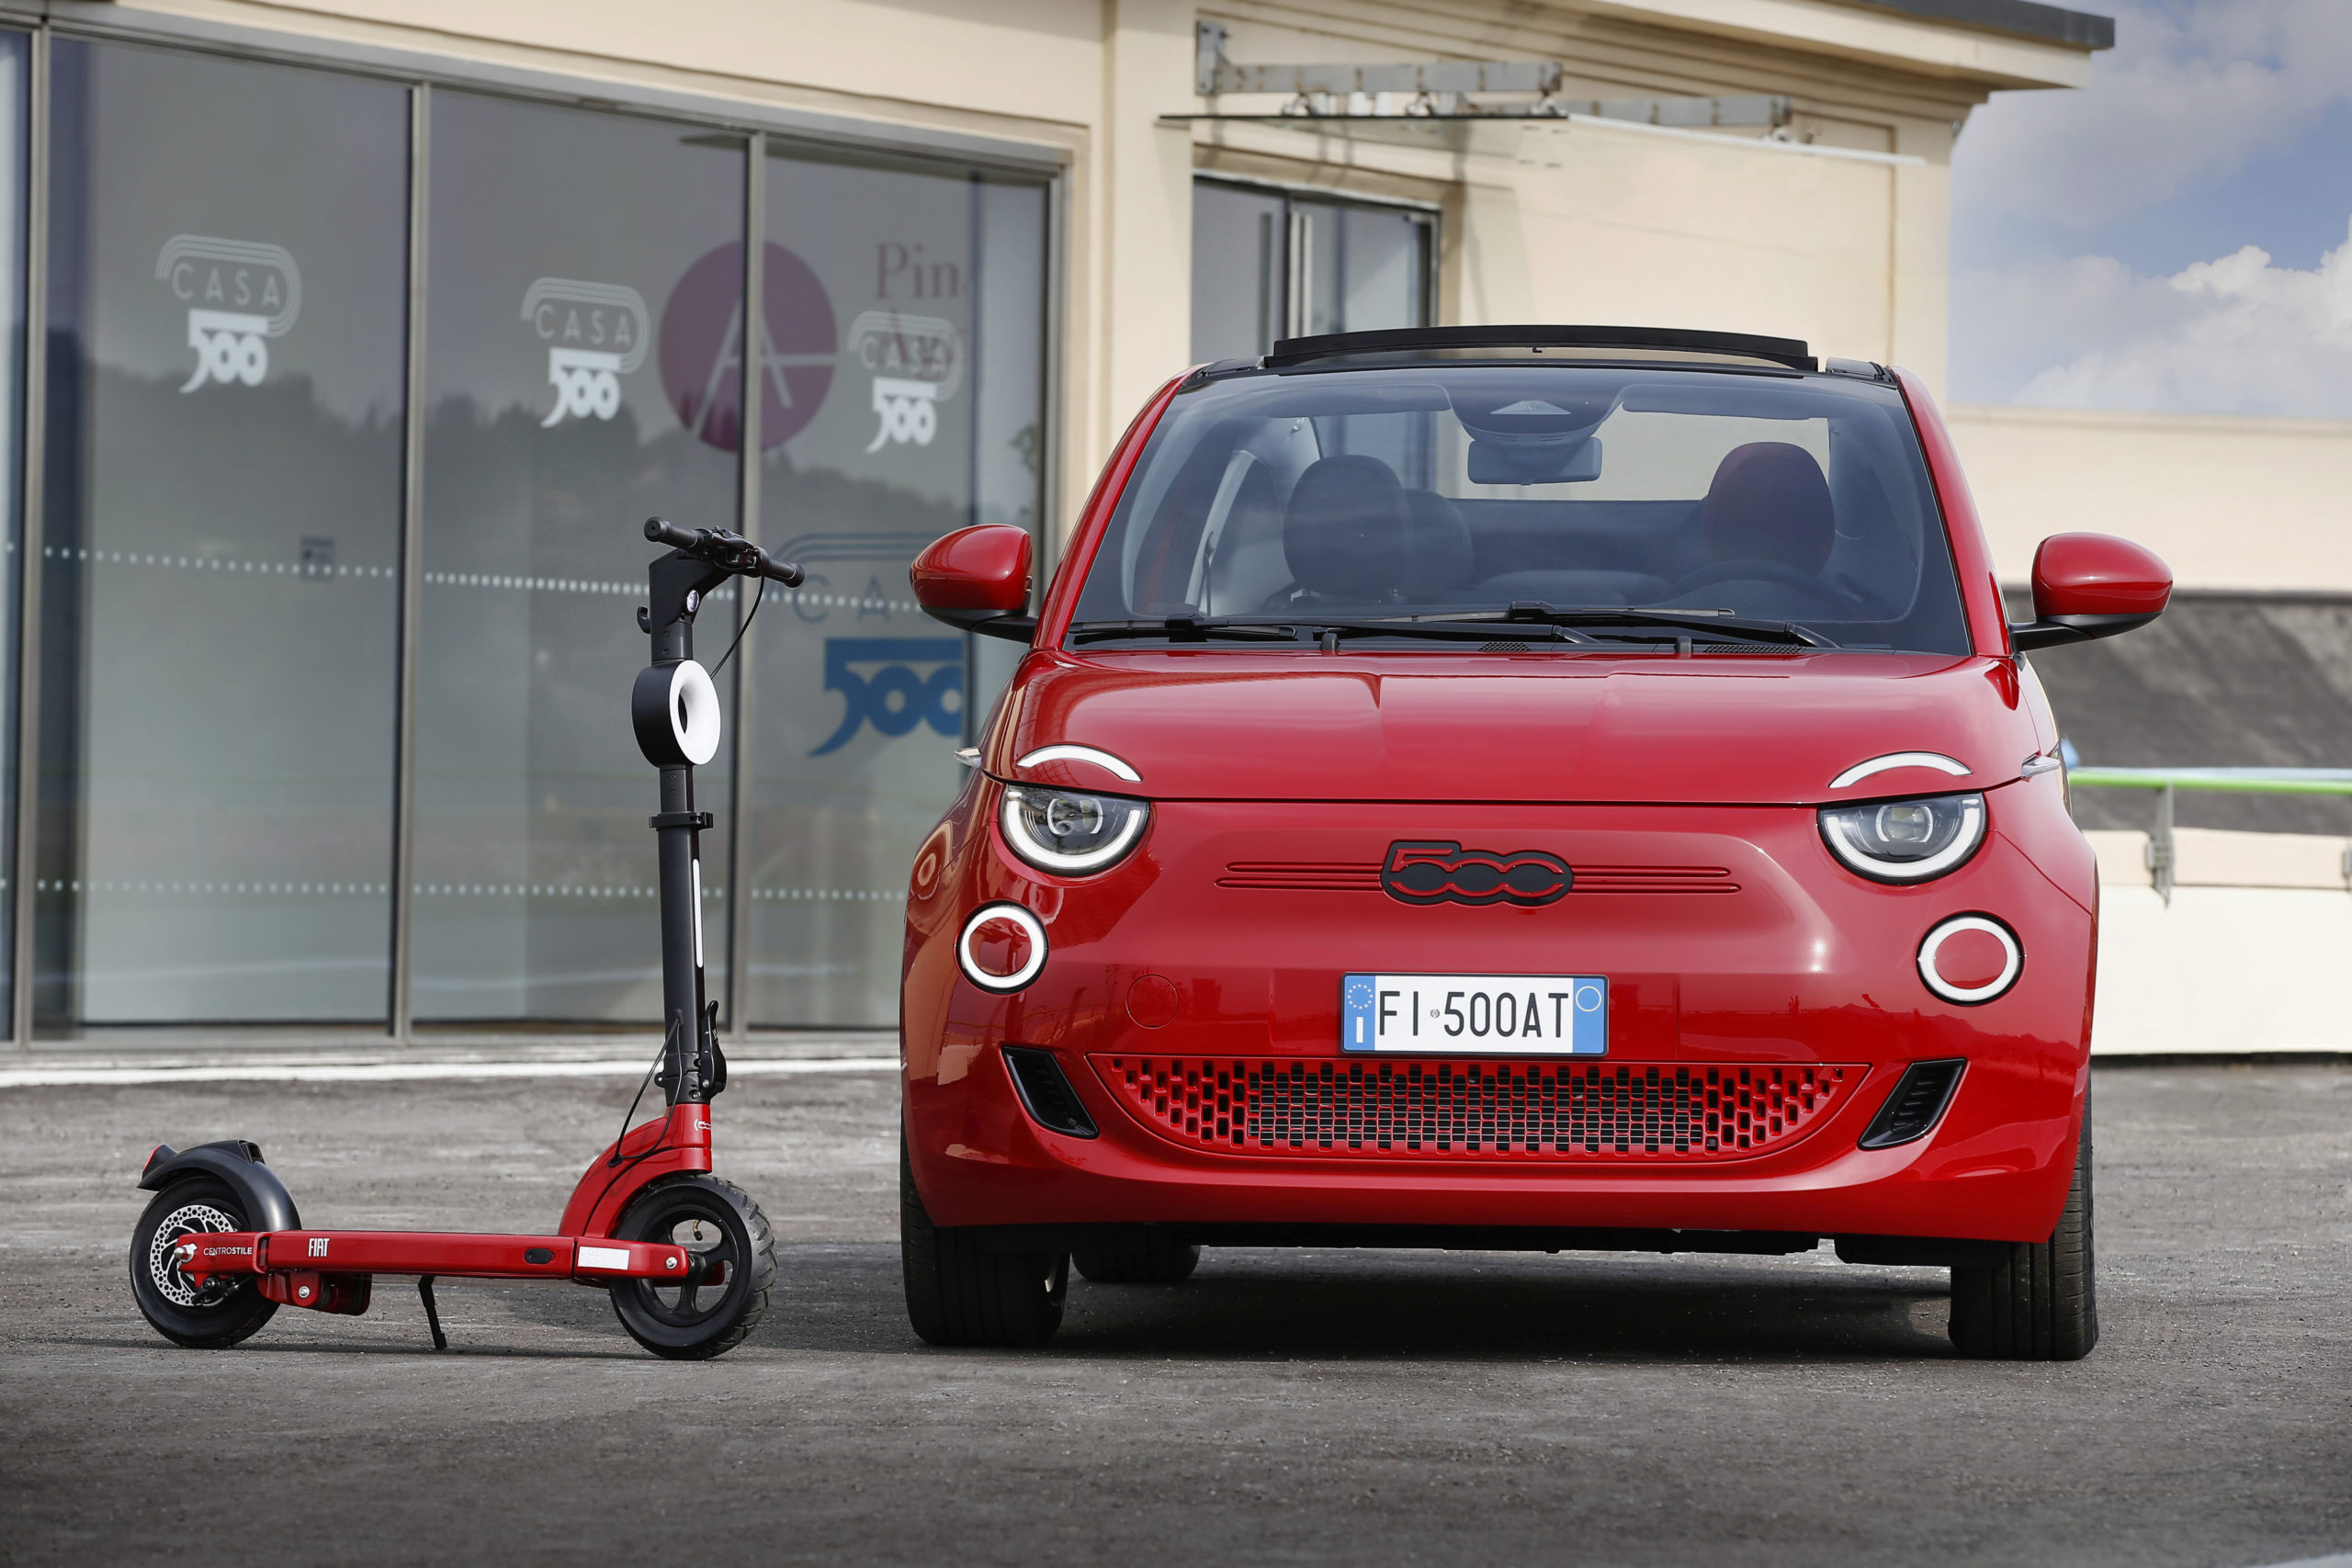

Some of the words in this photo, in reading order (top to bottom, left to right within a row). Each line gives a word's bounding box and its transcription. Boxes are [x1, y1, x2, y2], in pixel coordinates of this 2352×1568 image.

[172, 263, 281, 308] CASA
[874, 242, 968, 300] Pin
[179, 309, 269, 394] 500
[534, 303, 632, 346] CASA
[860, 334, 945, 374] CASA
[540, 346, 621, 428] 500
[865, 376, 937, 454] 500
[806, 638, 963, 758] 500
[1385, 843, 1568, 902] 500
[203, 1247, 253, 1257] CENTROSTILE
[308, 1237, 330, 1258] FIAT
